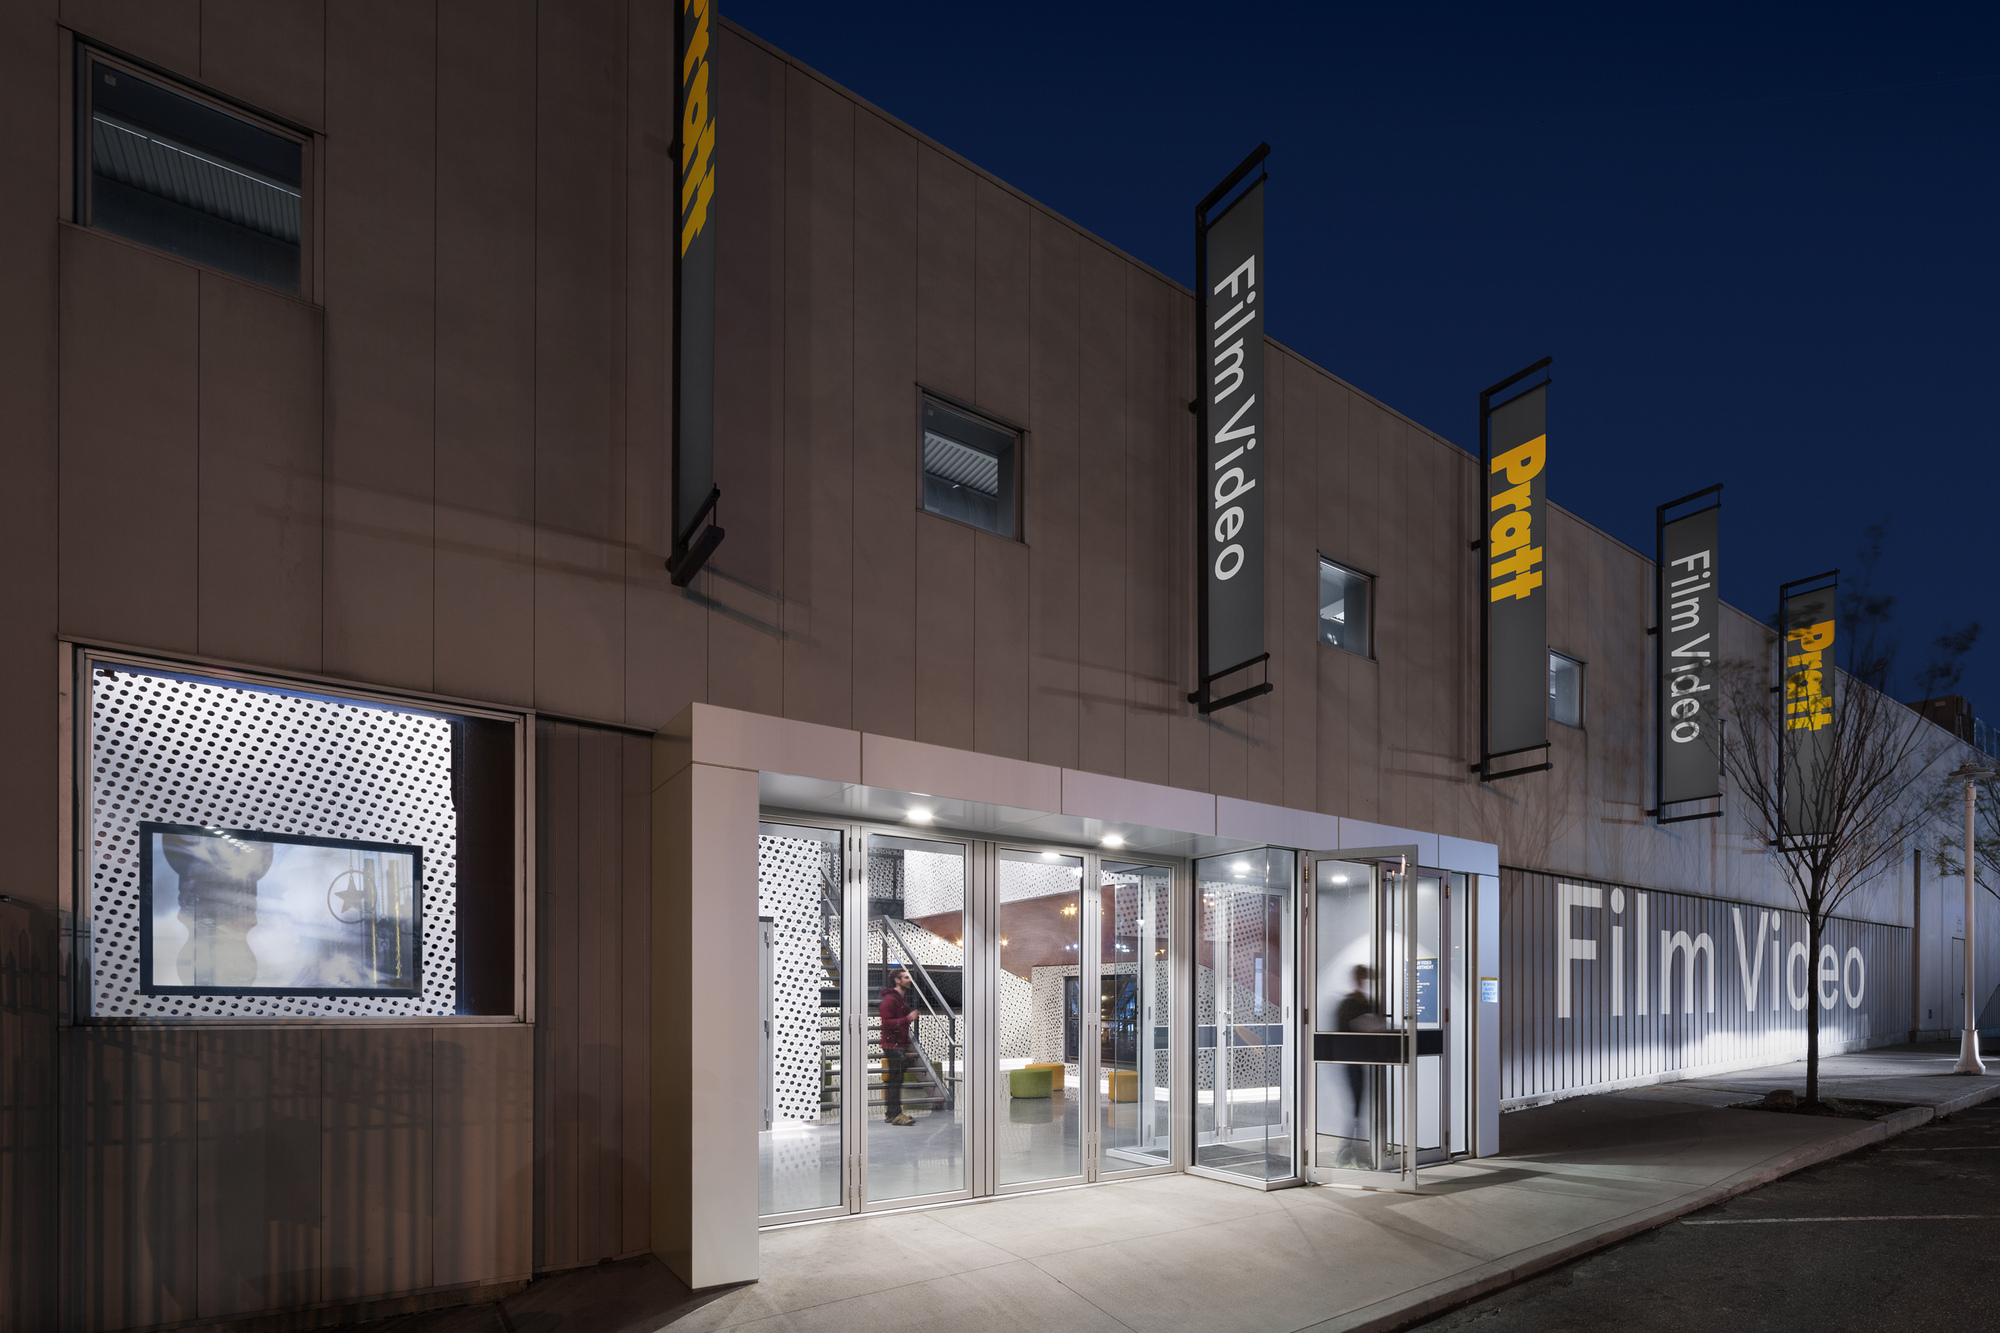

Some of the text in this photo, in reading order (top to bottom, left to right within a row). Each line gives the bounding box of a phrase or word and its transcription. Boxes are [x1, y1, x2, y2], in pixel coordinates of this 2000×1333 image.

[682, 0, 715, 260] ratt
[1214, 255, 1256, 581] Film Video
[1491, 434, 1546, 602] Pratt
[1671, 550, 1711, 743] Film Video
[1787, 619, 1835, 731] Pratt
[1557, 882, 1865, 1019] Film Video
